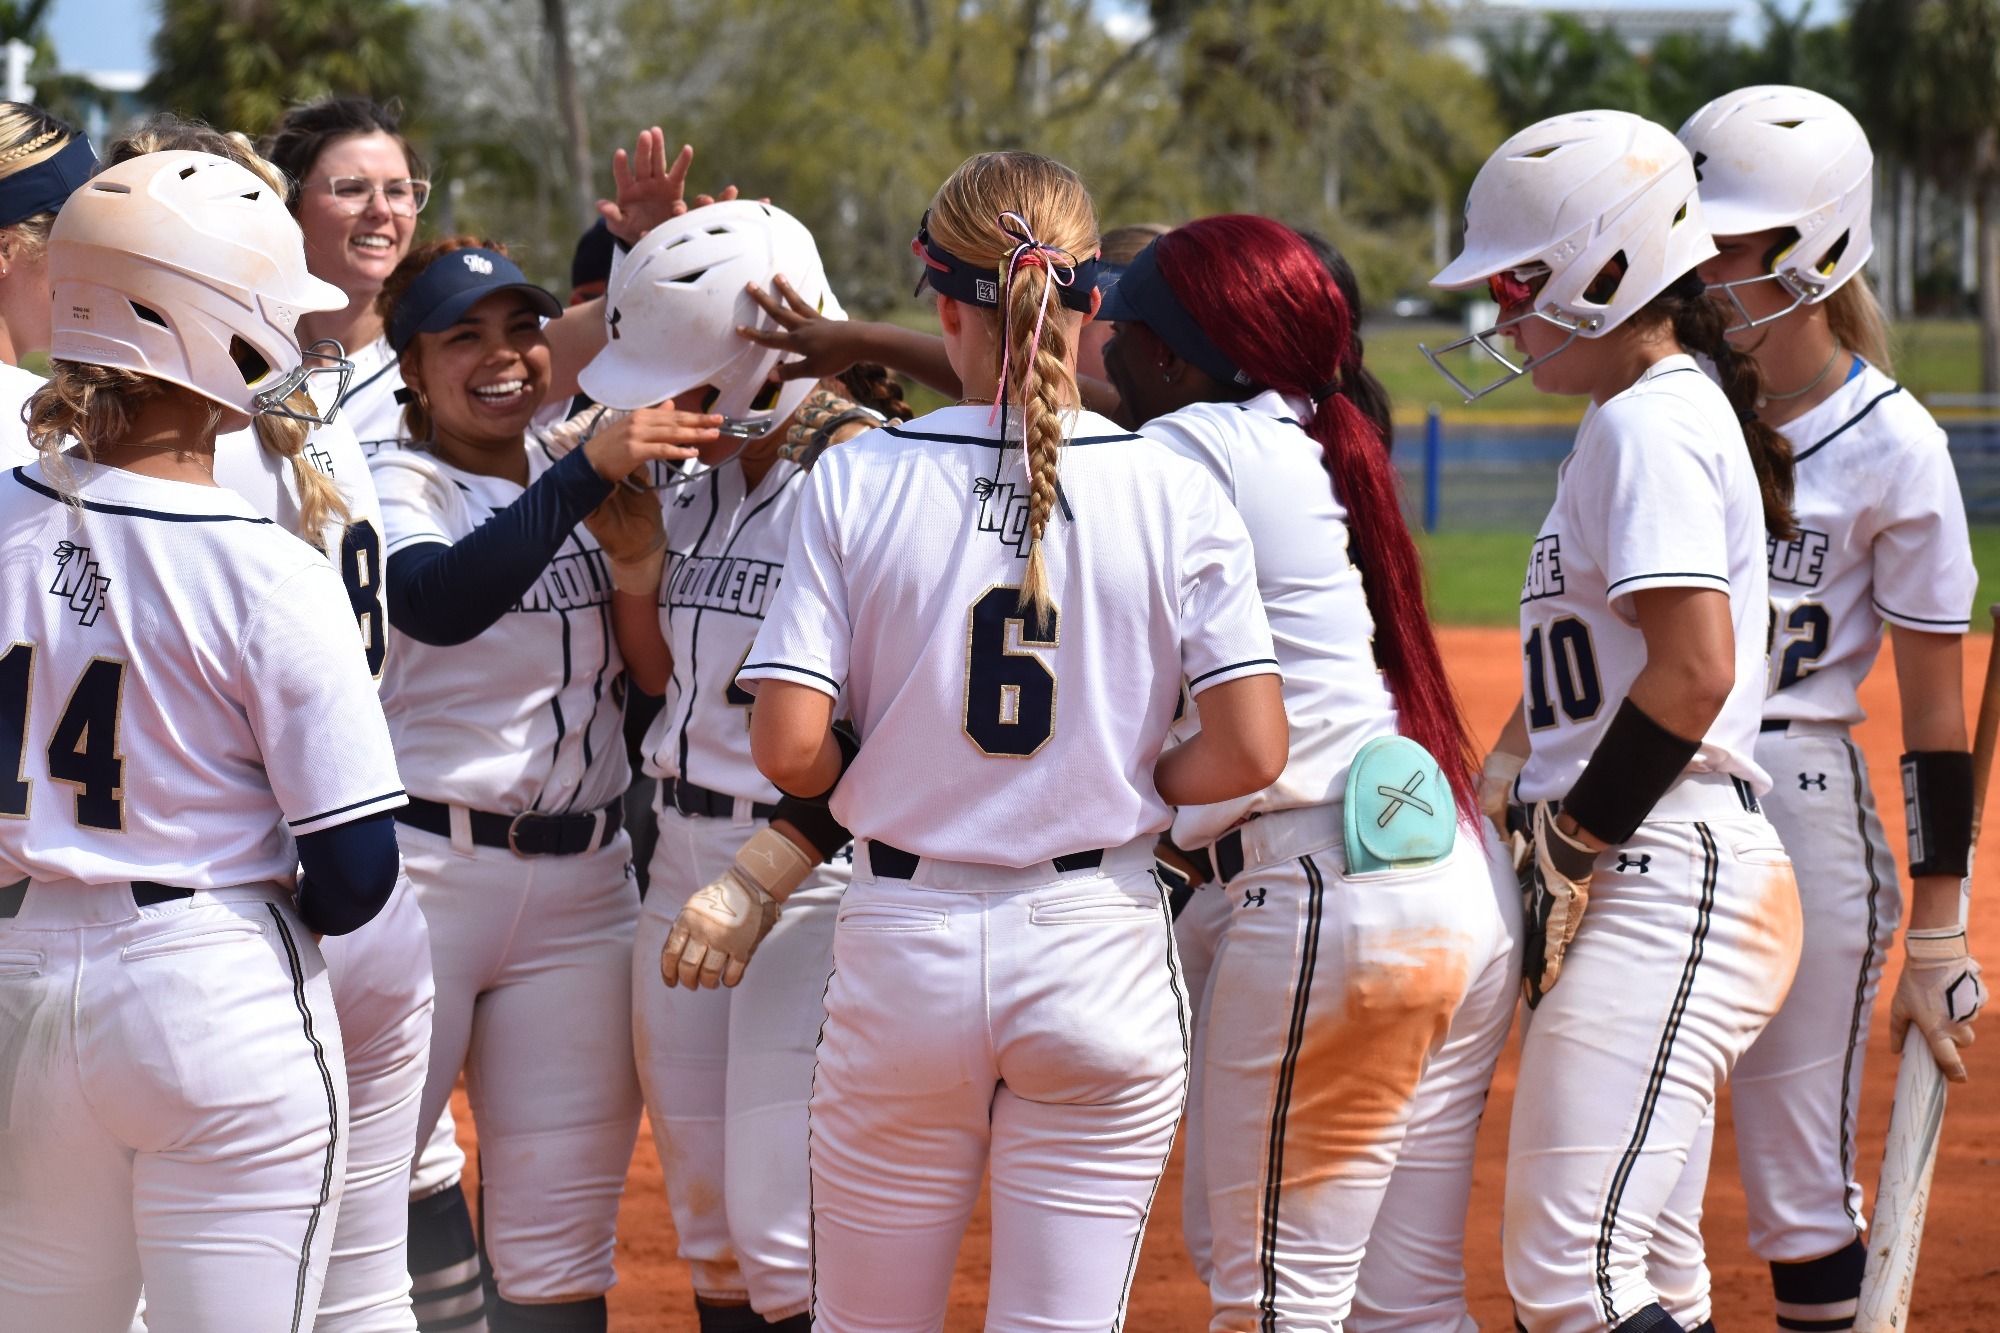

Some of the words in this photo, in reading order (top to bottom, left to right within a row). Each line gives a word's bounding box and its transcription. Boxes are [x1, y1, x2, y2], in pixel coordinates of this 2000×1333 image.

[49, 546, 112, 628] NCF
[0, 640, 128, 834] 14
[962, 583, 1061, 759] 6
[1524, 612, 1606, 734] 10
